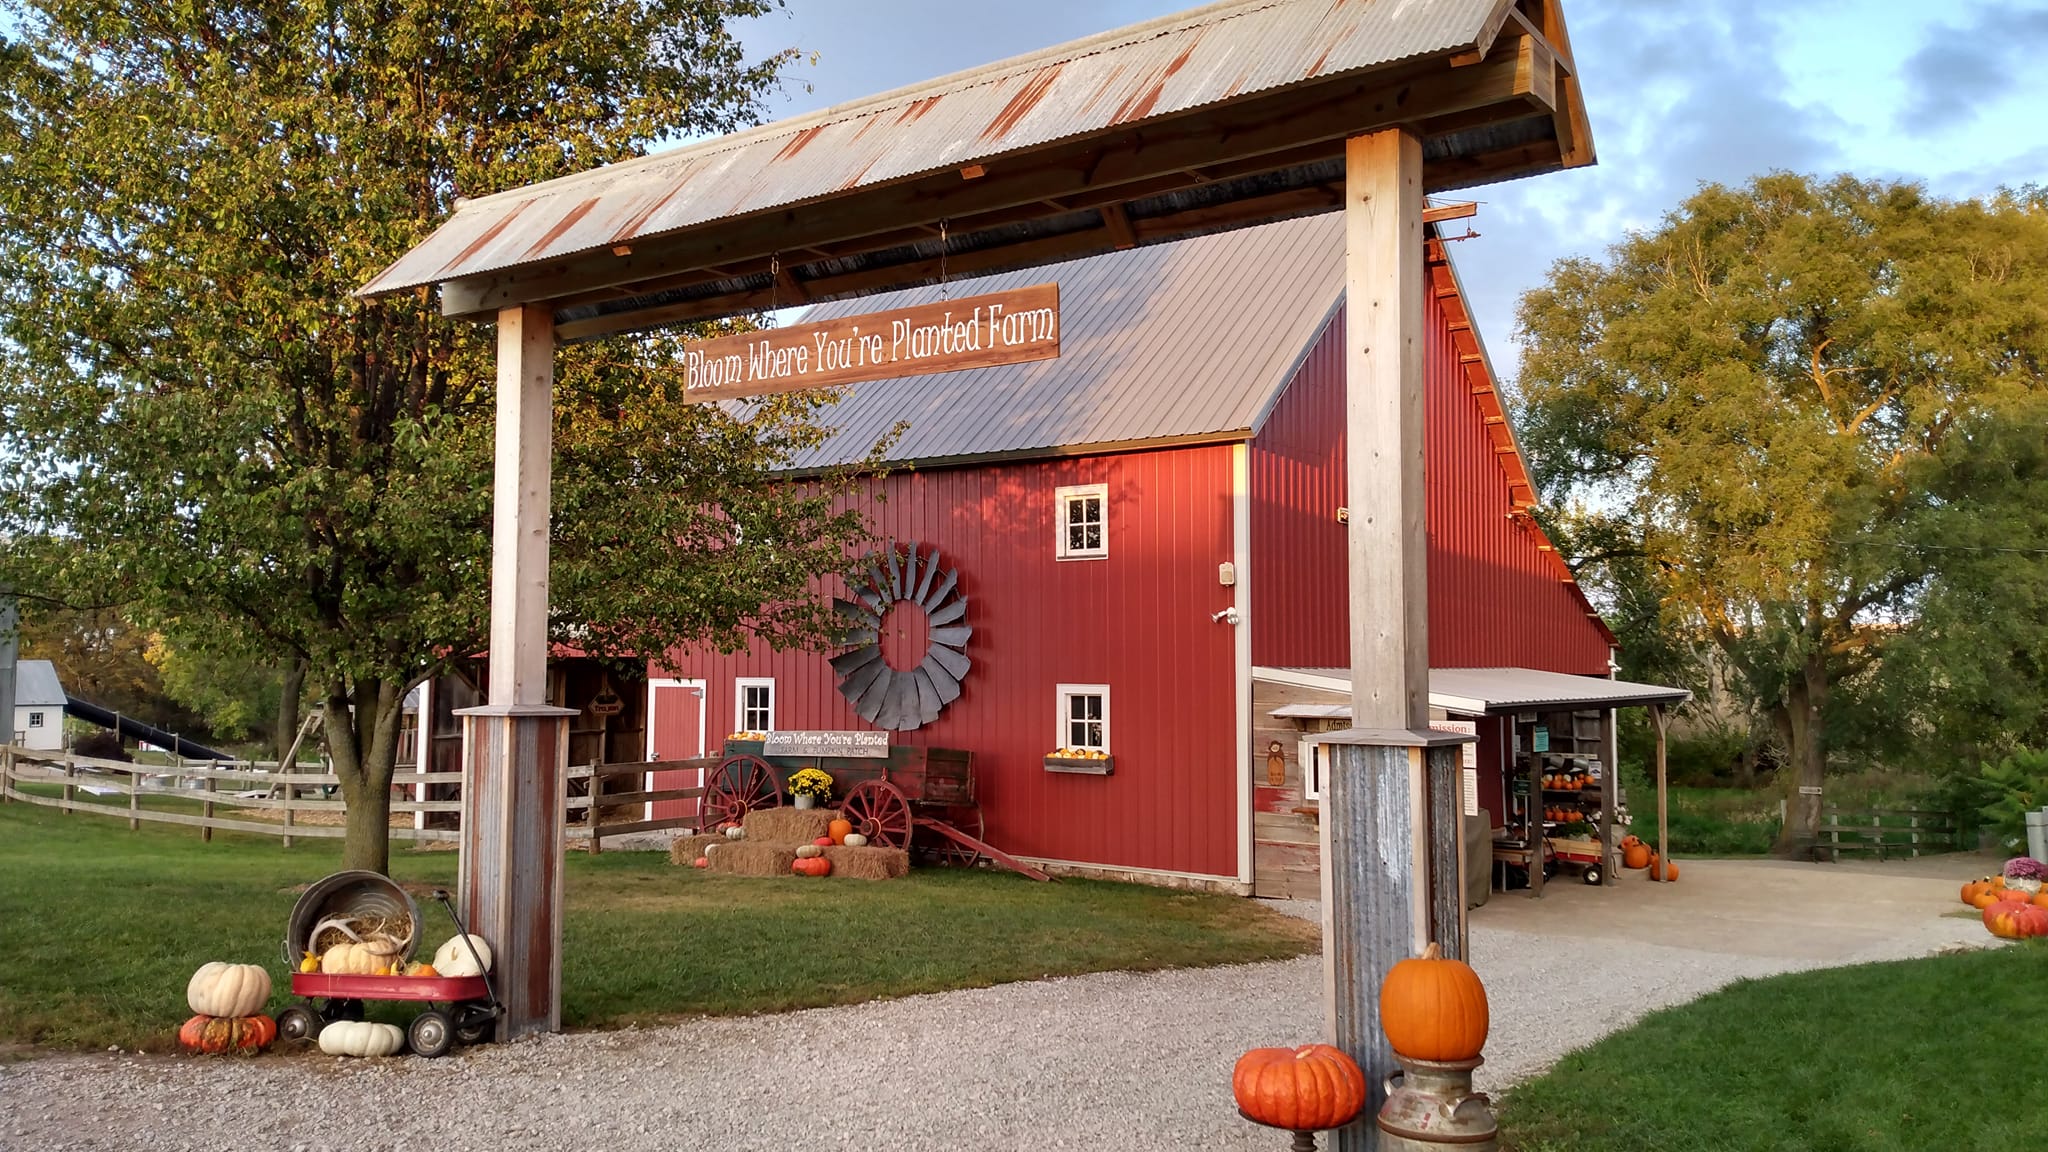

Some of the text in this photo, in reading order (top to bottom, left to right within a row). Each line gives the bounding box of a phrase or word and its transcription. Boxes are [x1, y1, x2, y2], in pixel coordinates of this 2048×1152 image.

[687, 303, 1054, 390] Bloom Where You're Planted Farm
[1326, 719, 1352, 731] Admis
[765, 732, 888, 746] Bloom Where You're Planted
[846, 747, 869, 756] PATCH
